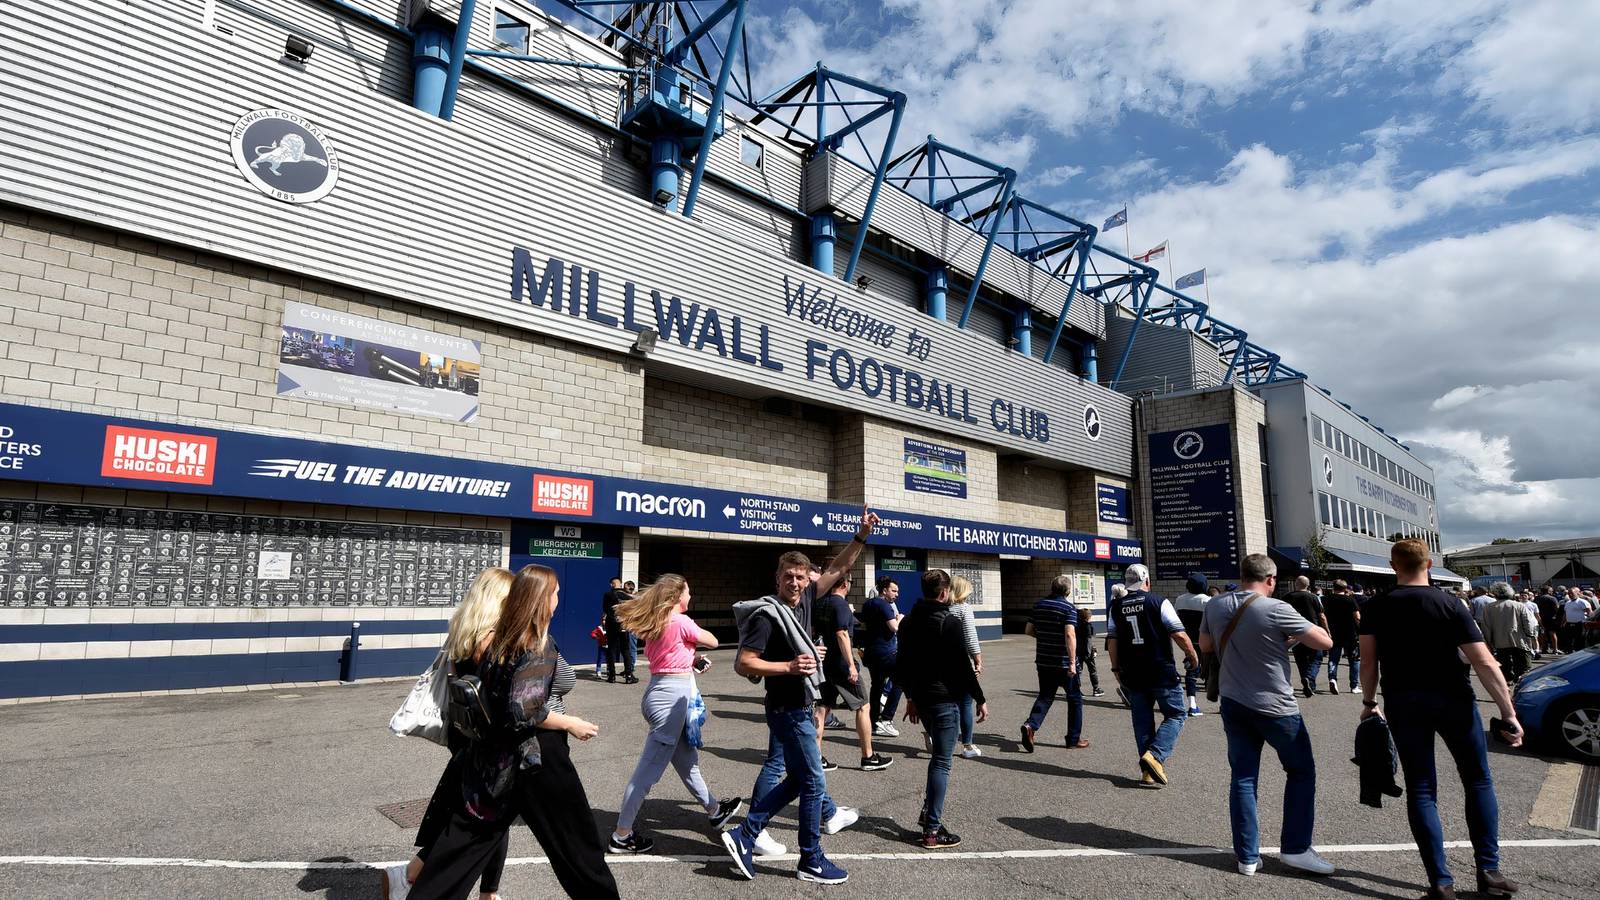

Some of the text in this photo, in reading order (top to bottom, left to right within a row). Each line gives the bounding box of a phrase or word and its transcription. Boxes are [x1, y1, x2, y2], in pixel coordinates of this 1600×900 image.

[233, 111, 338, 171] MILLWALL FOOTBALL CLUB
[271, 188, 295, 201] 1885
[782, 274, 932, 362] Welcome to
[300, 308, 407, 339] CONFERENCING
[424, 335, 467, 351] EVENTS
[510, 246, 1050, 443] MILLWALL FOOTBALL CLUB
[114, 435, 208, 465] HUSKI
[113, 458, 205, 477] CHOCOLATE
[1181, 461, 1213, 470] FOOTBALL
[1213, 459, 1230, 467] CLUB
[258, 459, 512, 499] FUEL THE ADVENTURE!
[1355, 476, 1368, 496] THE
[537, 479, 589, 502] HUSKI
[537, 498, 588, 512] CHOCOLATE
[616, 490, 706, 519] macron
[740, 497, 800, 513] NORTH STAND
[740, 508, 776, 521] VISITING
[827, 512, 842, 522] THE
[902, 520, 922, 530] STAND
[560, 527, 576, 537] W3
[740, 519, 792, 533] SUPPORTERS
[827, 523, 855, 533] BLOCKS
[873, 527, 890, 536] 27-30
[533, 540, 579, 549] EMERGENCY
[935, 524, 961, 543] THE
[963, 528, 1001, 546] BARRY
[1002, 533, 1057, 551] KITCHENER
[1058, 538, 1088, 554] STAND
[542, 548, 587, 557] KEEP CLEAR
[1117, 545, 1143, 558] macron
[1122, 604, 1144, 615] COACH
[1126, 615, 1145, 645] 1
[423, 707, 440, 719] GR
